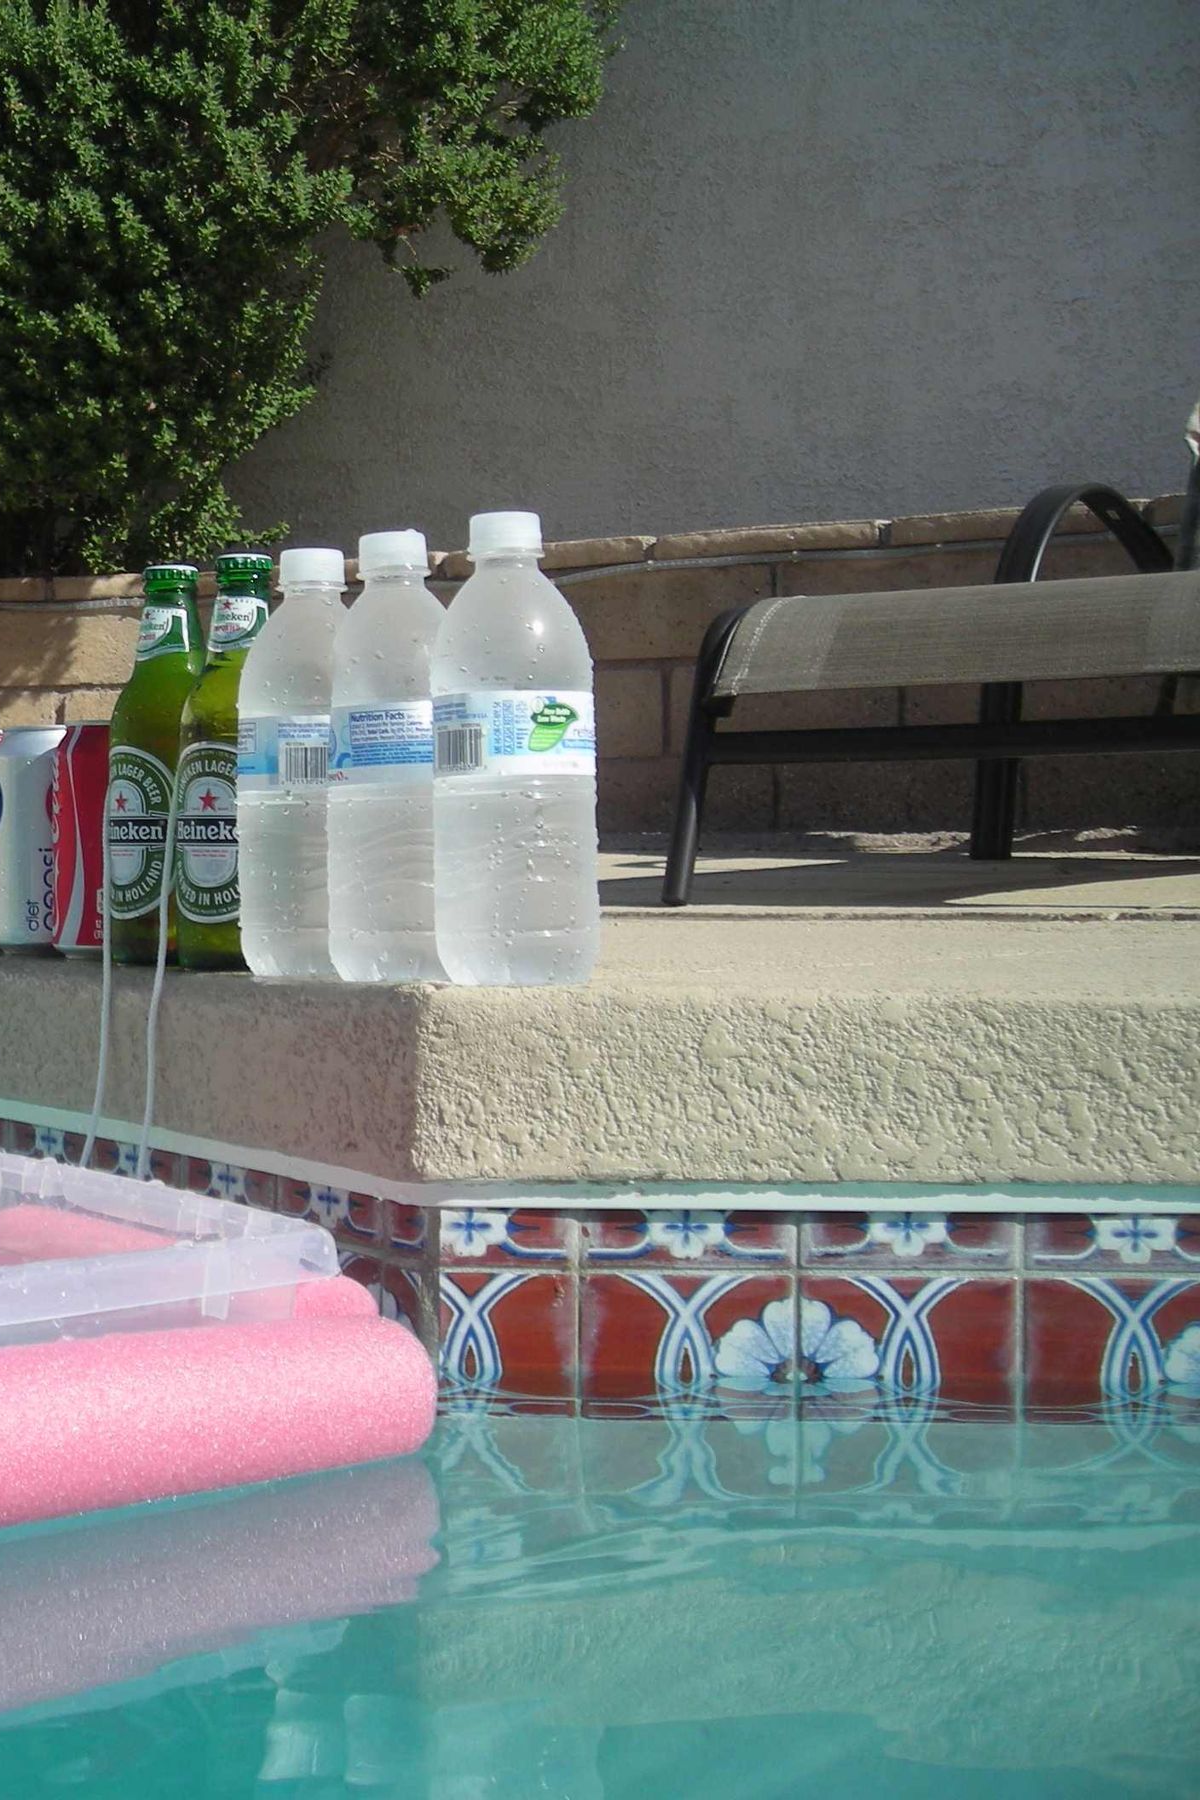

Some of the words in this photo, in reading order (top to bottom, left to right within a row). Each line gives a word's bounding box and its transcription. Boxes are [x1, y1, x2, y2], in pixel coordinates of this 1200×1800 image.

[351, 713, 383, 722] Nutrition
[385, 711, 405, 720] Facts
[118, 763, 145, 782] LAGER
[142, 777, 162, 805] BEER
[110, 821, 164, 840] ineken
[177, 821, 240, 841] Heineke
[125, 860, 163, 902] HOLLAND
[199, 892, 211, 905] IN
[26, 899, 39, 932] diet
